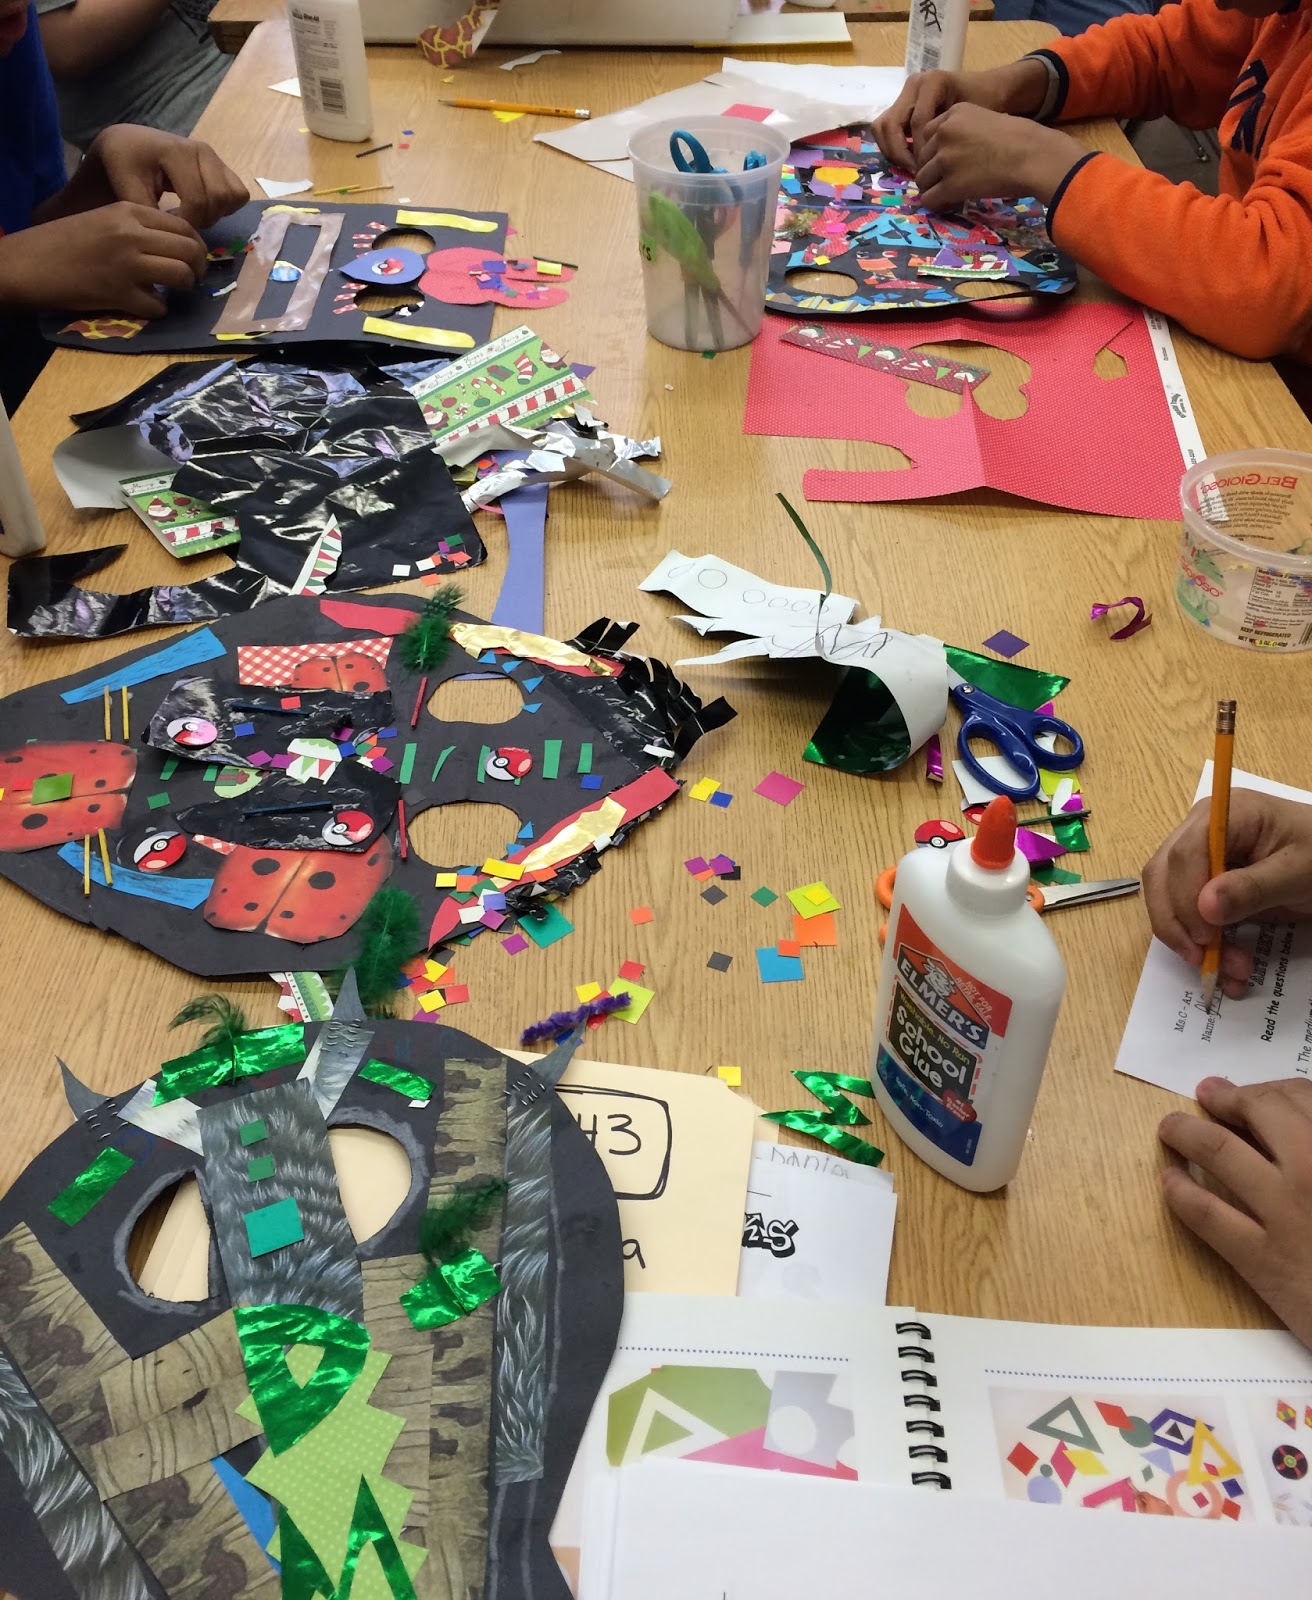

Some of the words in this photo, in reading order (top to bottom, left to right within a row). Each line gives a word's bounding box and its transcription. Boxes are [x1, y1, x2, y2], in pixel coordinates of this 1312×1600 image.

[1273, 958, 1289, 998] questions
[900, 958, 983, 1041] ELMER'S
[1267, 1000, 1280, 1016] the
[896, 1006, 967, 1084] School
[1260, 1017, 1276, 1042] Read
[899, 1032, 943, 1088] Glue
[938, 1034, 950, 1049] No
[952, 1046, 970, 1066] Run
[1298, 1045, 1312, 1062] The
